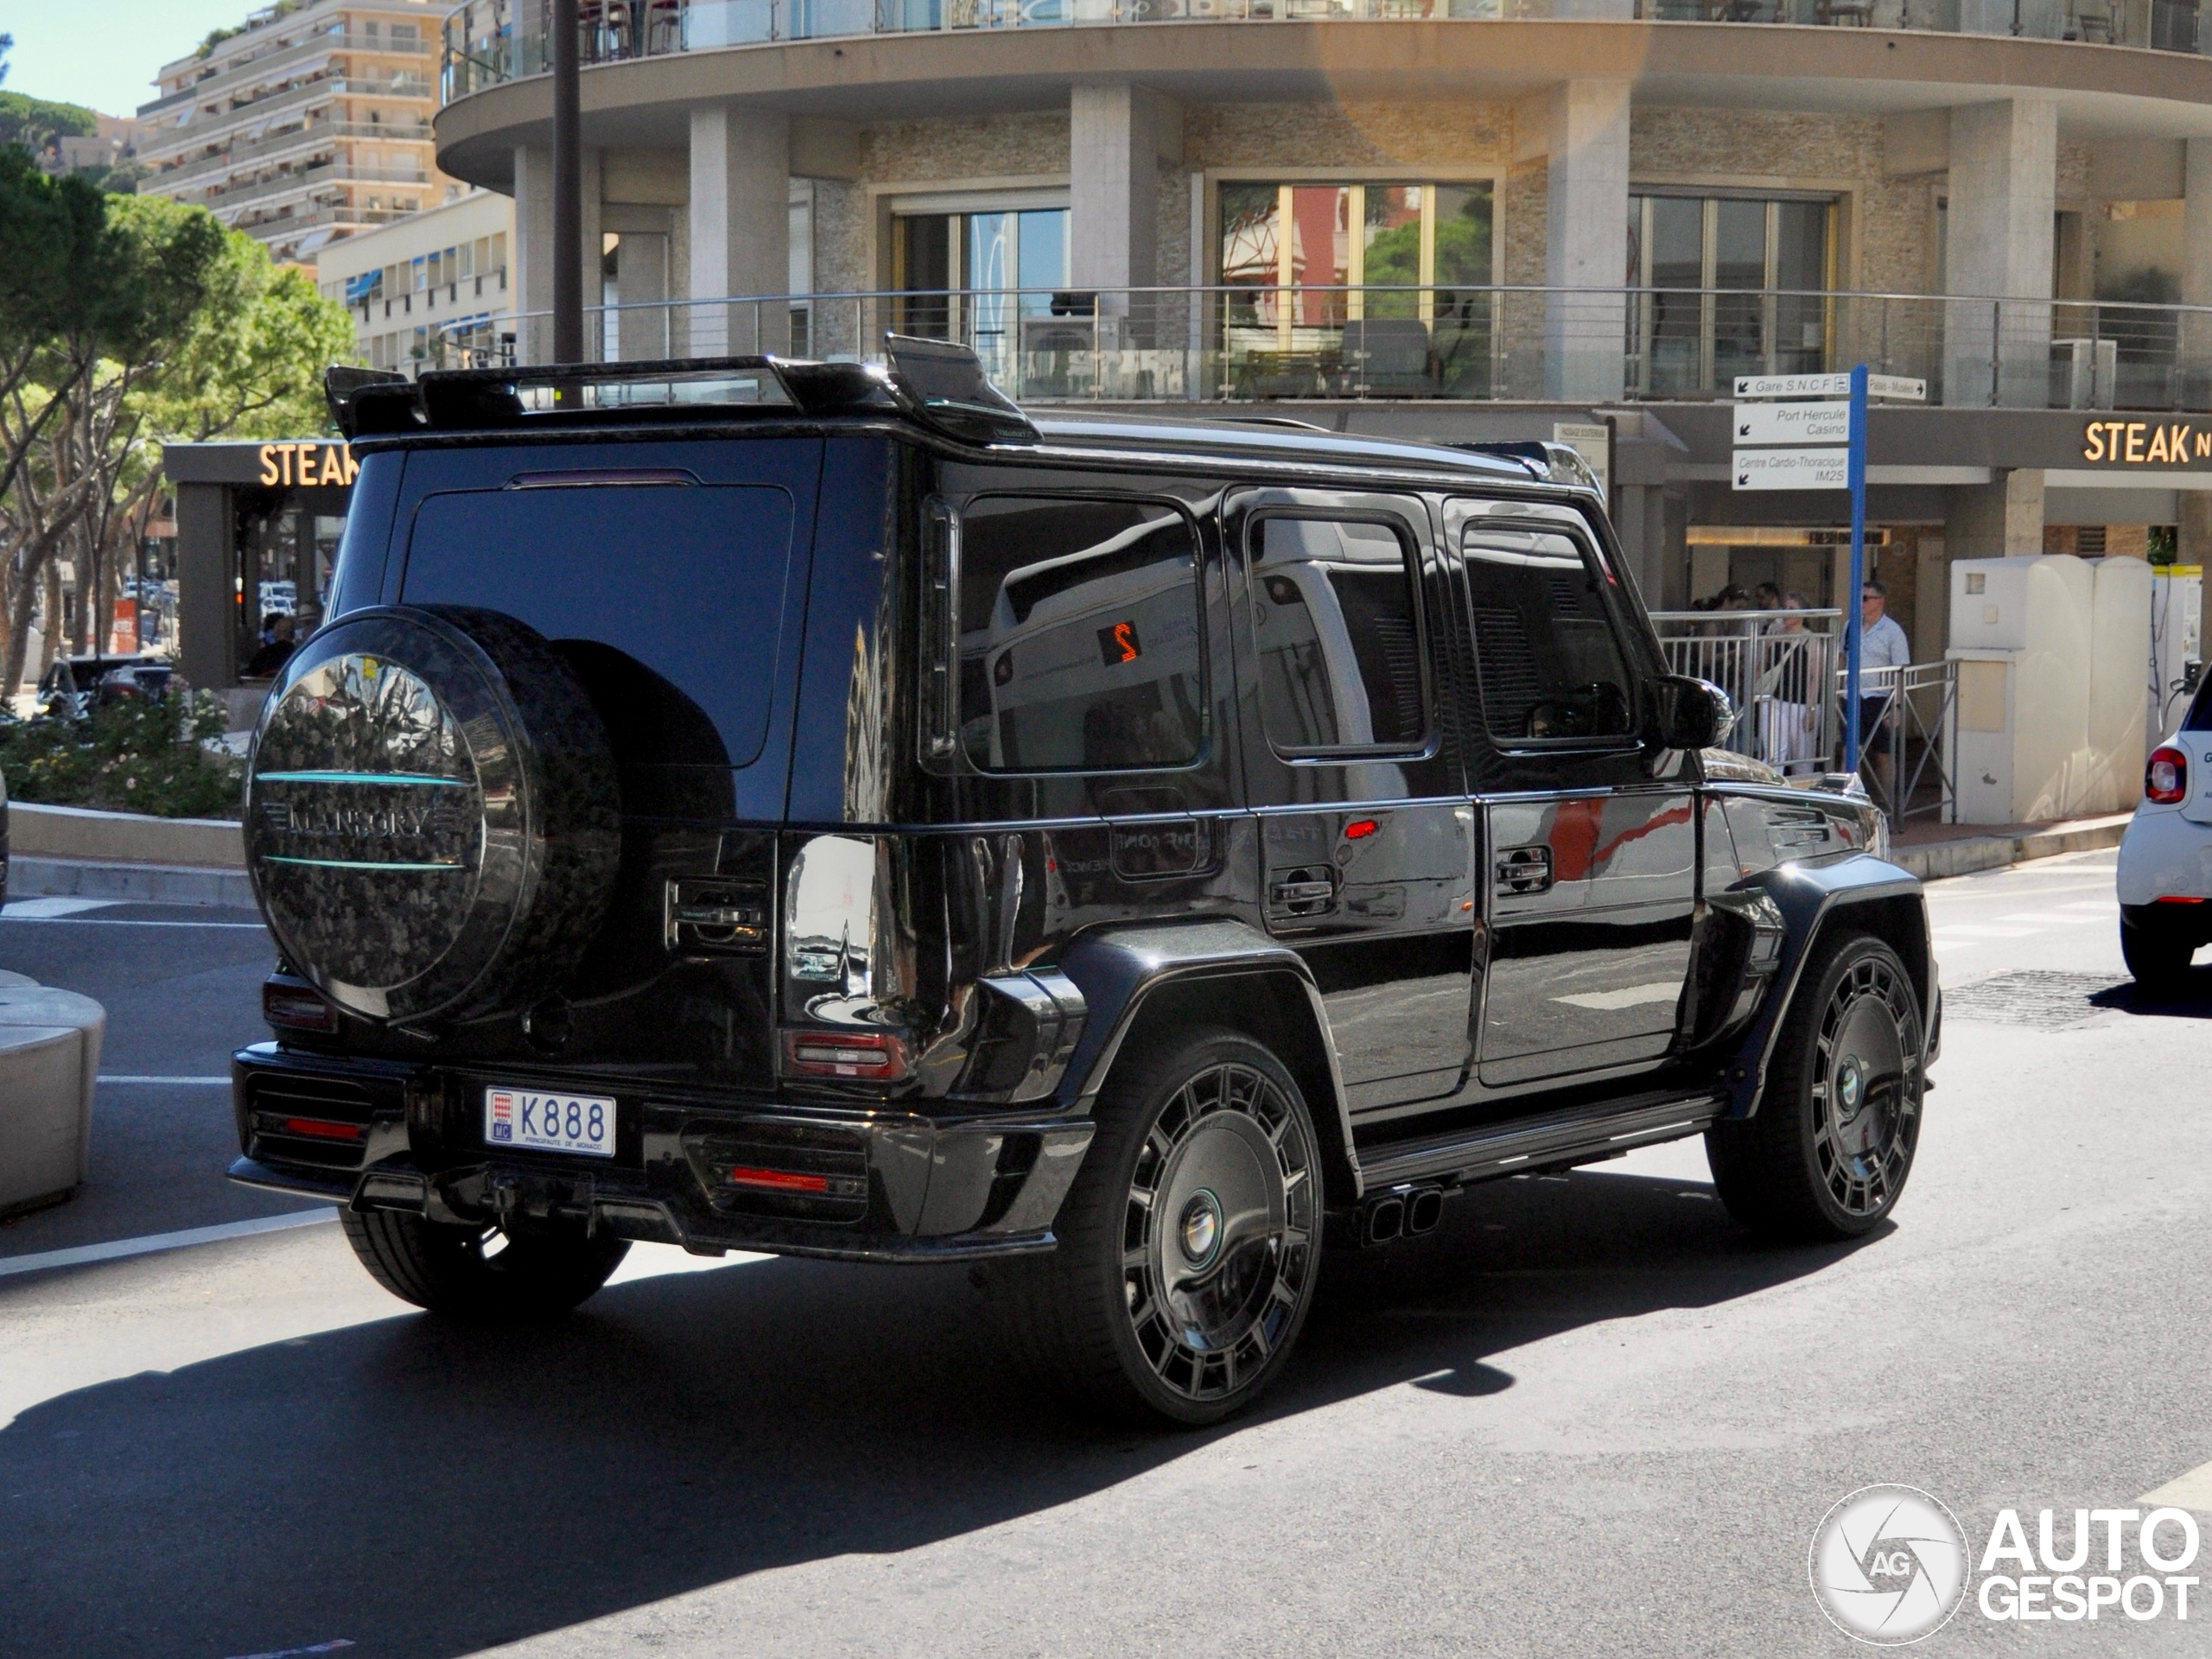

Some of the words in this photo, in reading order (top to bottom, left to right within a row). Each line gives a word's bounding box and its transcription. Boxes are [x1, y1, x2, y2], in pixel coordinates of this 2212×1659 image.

[1756, 381, 1783, 392] Gare
[1777, 410, 1801, 421] Port
[1802, 409, 1846, 420] Hercule
[1807, 423, 1846, 435] Casino
[2084, 422, 2190, 463] STEAK
[1739, 457, 1767, 468] Centre
[1769, 455, 1846, 469] Cardio-Thoracique
[1815, 469, 1845, 481] IM2S
[521, 1096, 605, 1142] K888
[495, 1124, 509, 1138] MC
[576, 1141, 603, 1150] MONACO
